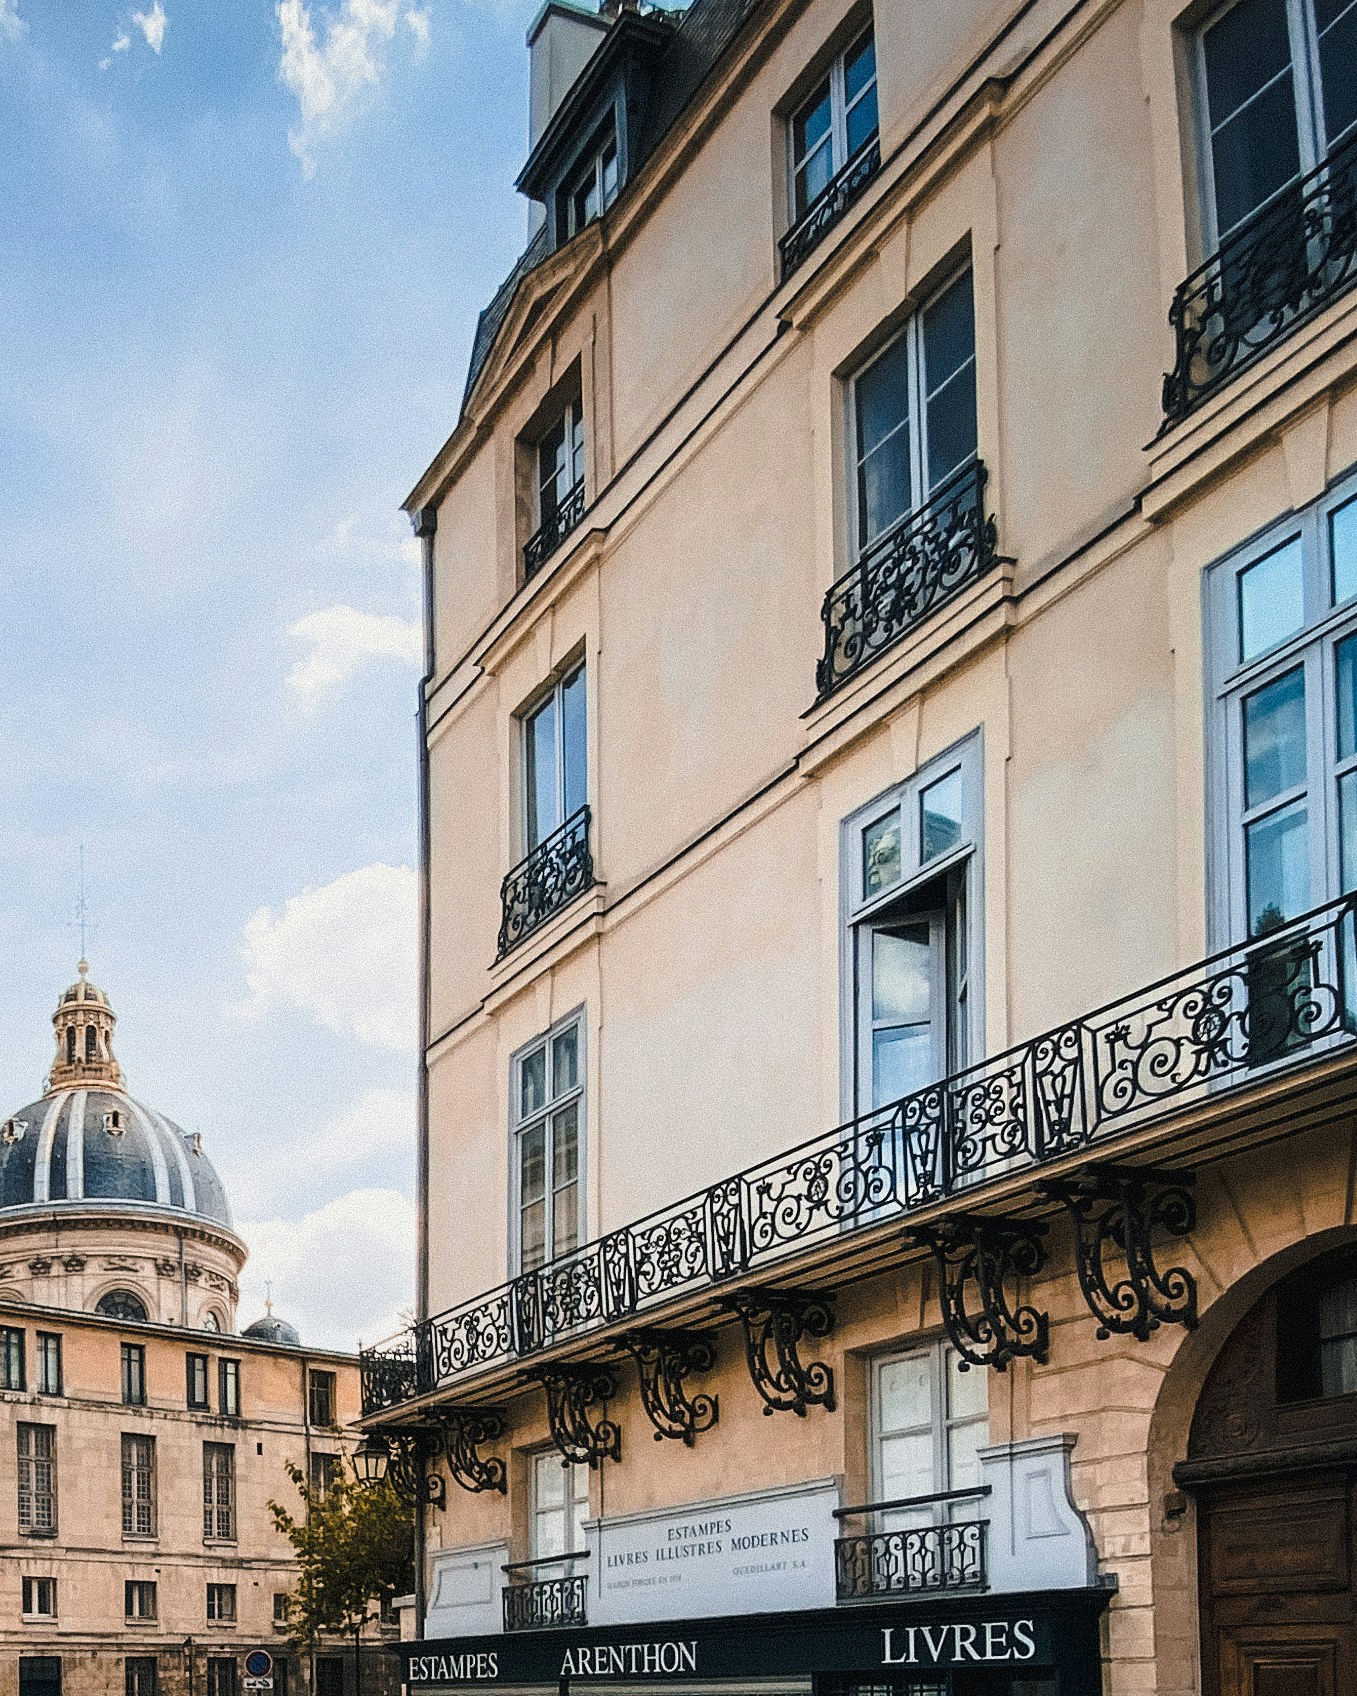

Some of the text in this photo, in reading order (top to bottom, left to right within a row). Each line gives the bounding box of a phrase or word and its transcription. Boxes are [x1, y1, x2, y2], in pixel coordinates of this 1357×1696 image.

[607, 1527, 810, 1568] LIVRES ILLUSTRES MODERNES
[667, 1518, 732, 1541] ESTAMPES
[408, 1641, 698, 1681] ESTAMPES ARENTHON
[881, 1619, 1036, 1664] LIVRES
